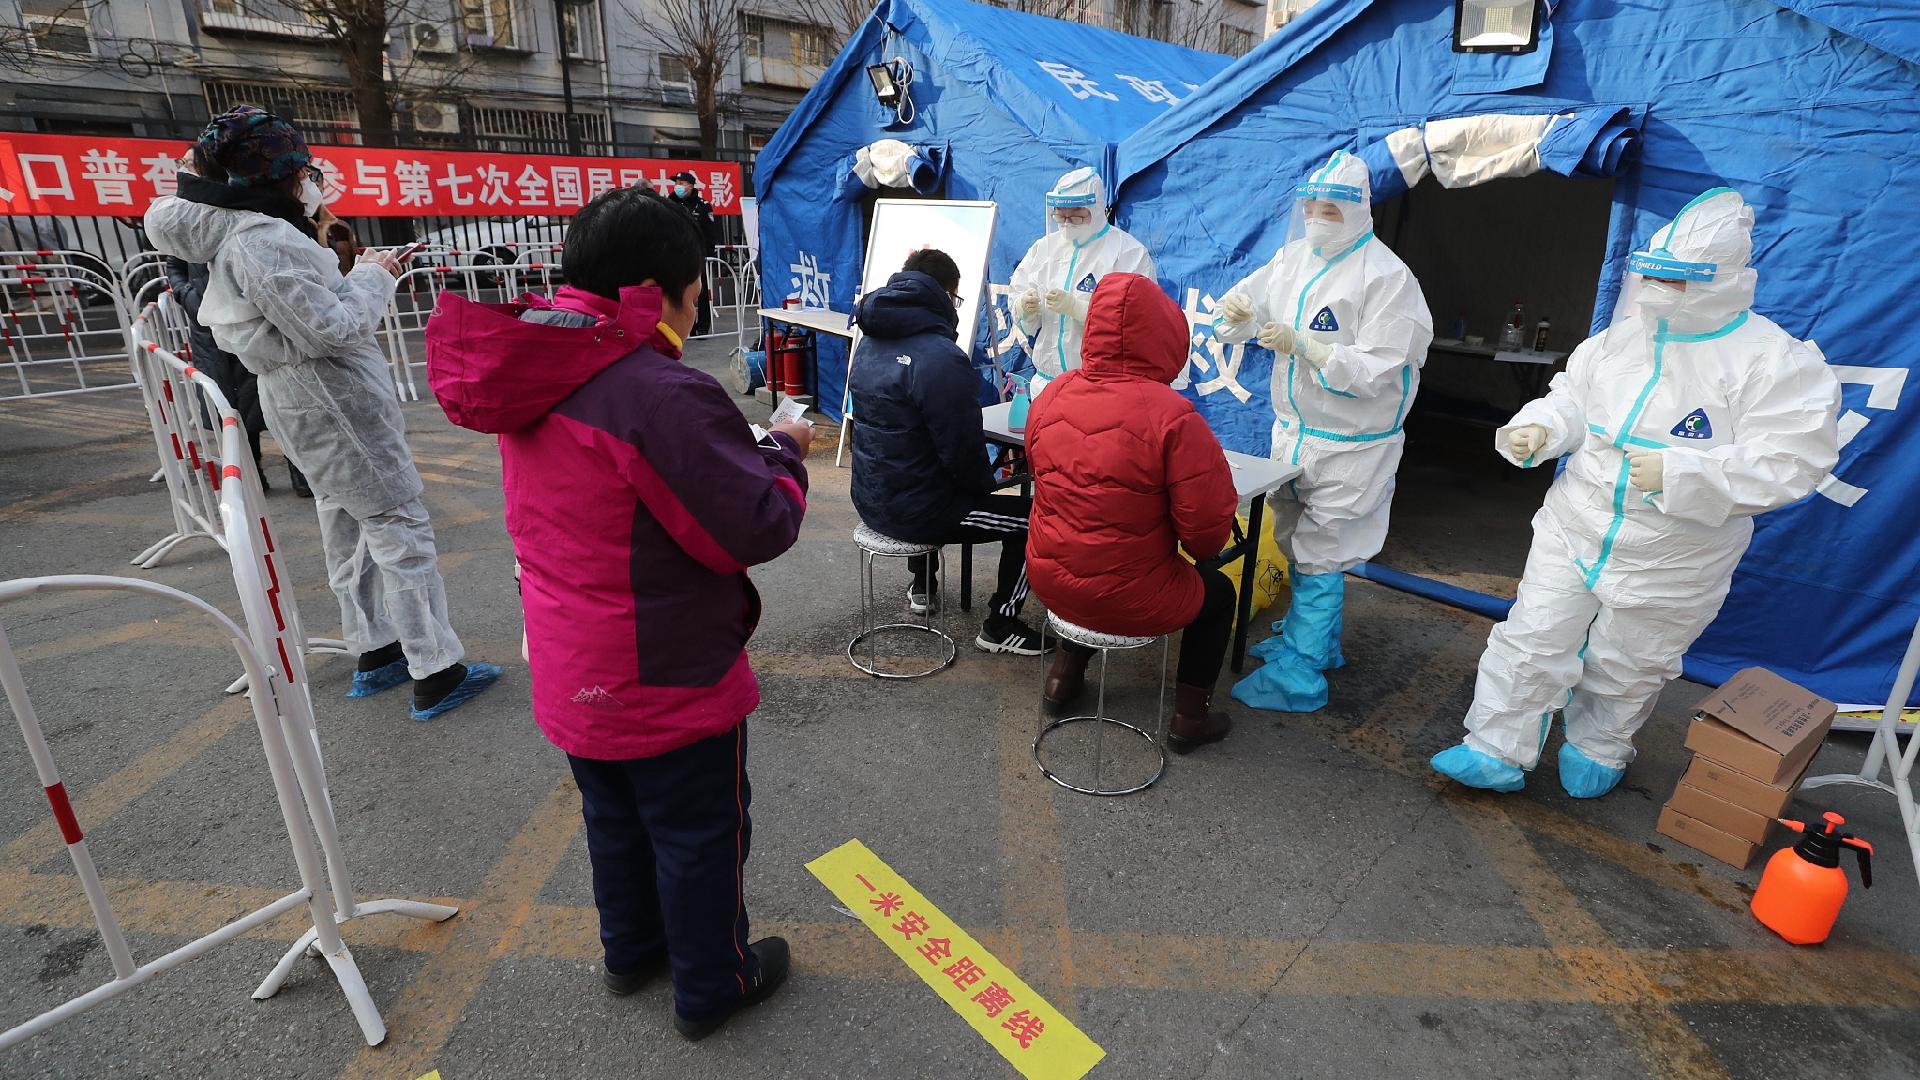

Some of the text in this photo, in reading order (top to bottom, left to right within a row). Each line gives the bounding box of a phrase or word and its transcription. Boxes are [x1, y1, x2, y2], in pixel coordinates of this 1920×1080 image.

[0, 148, 184, 206] 口普查
[1636, 258, 1662, 271] SHIELD
[855, 873, 1045, 1049] 一米安全距离线
